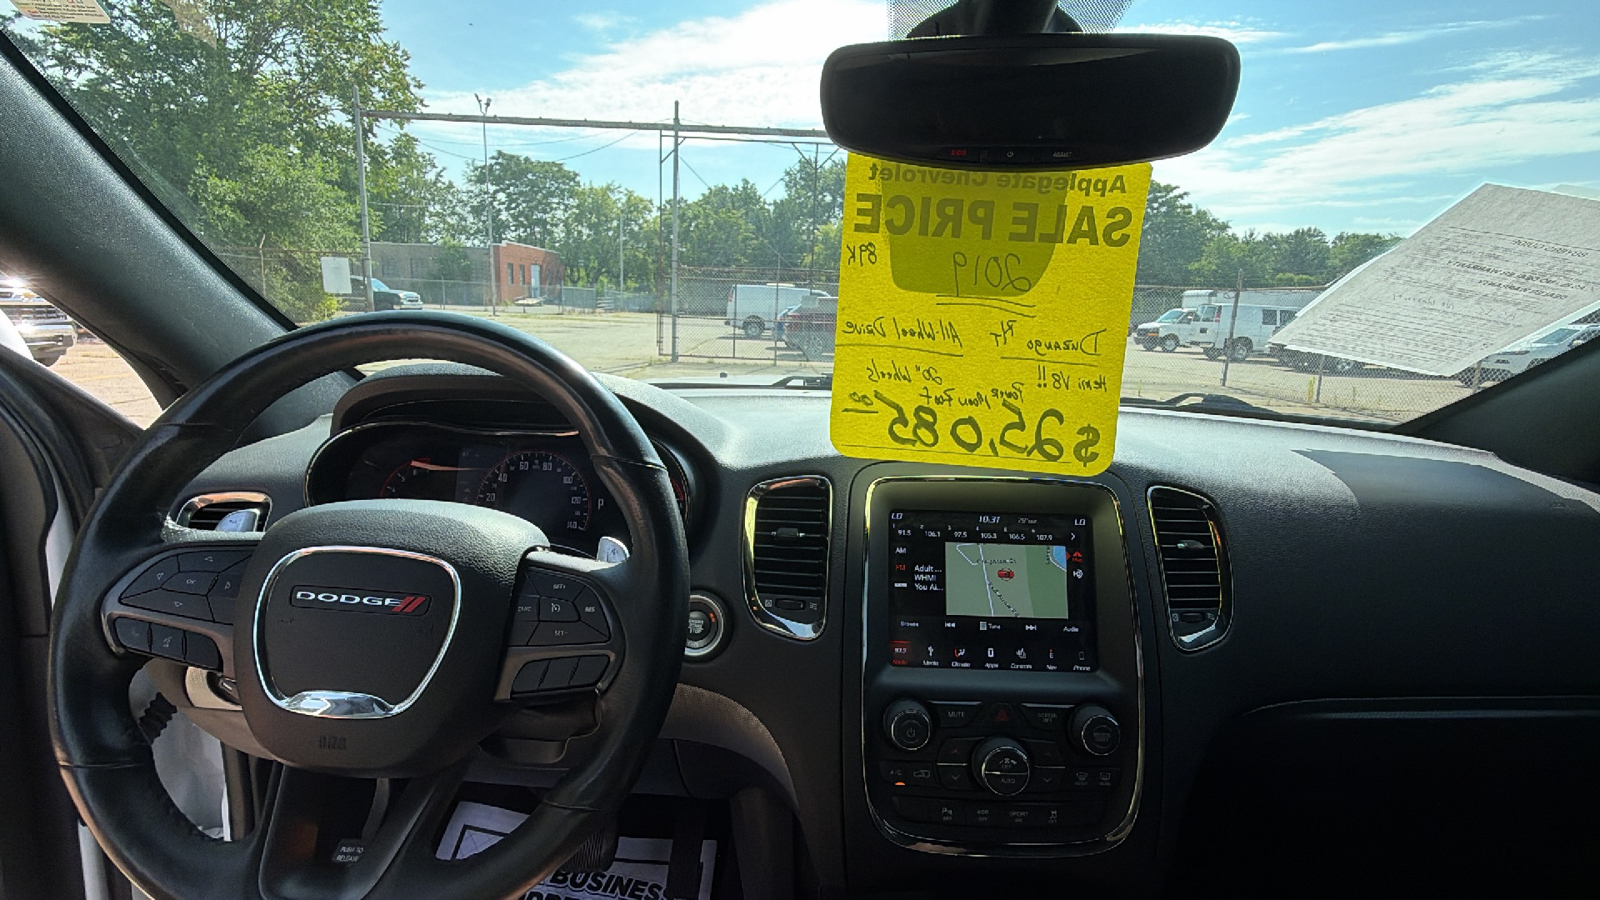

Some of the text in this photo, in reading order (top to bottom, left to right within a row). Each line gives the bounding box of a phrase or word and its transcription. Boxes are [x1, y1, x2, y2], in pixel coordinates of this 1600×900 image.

[914, 564, 934, 573] Adult
[914, 583, 928, 591] You
[296, 591, 404, 607] DODGE
[947, 710, 965, 718] MUTE
[548, 868, 668, 900] BUSINES
